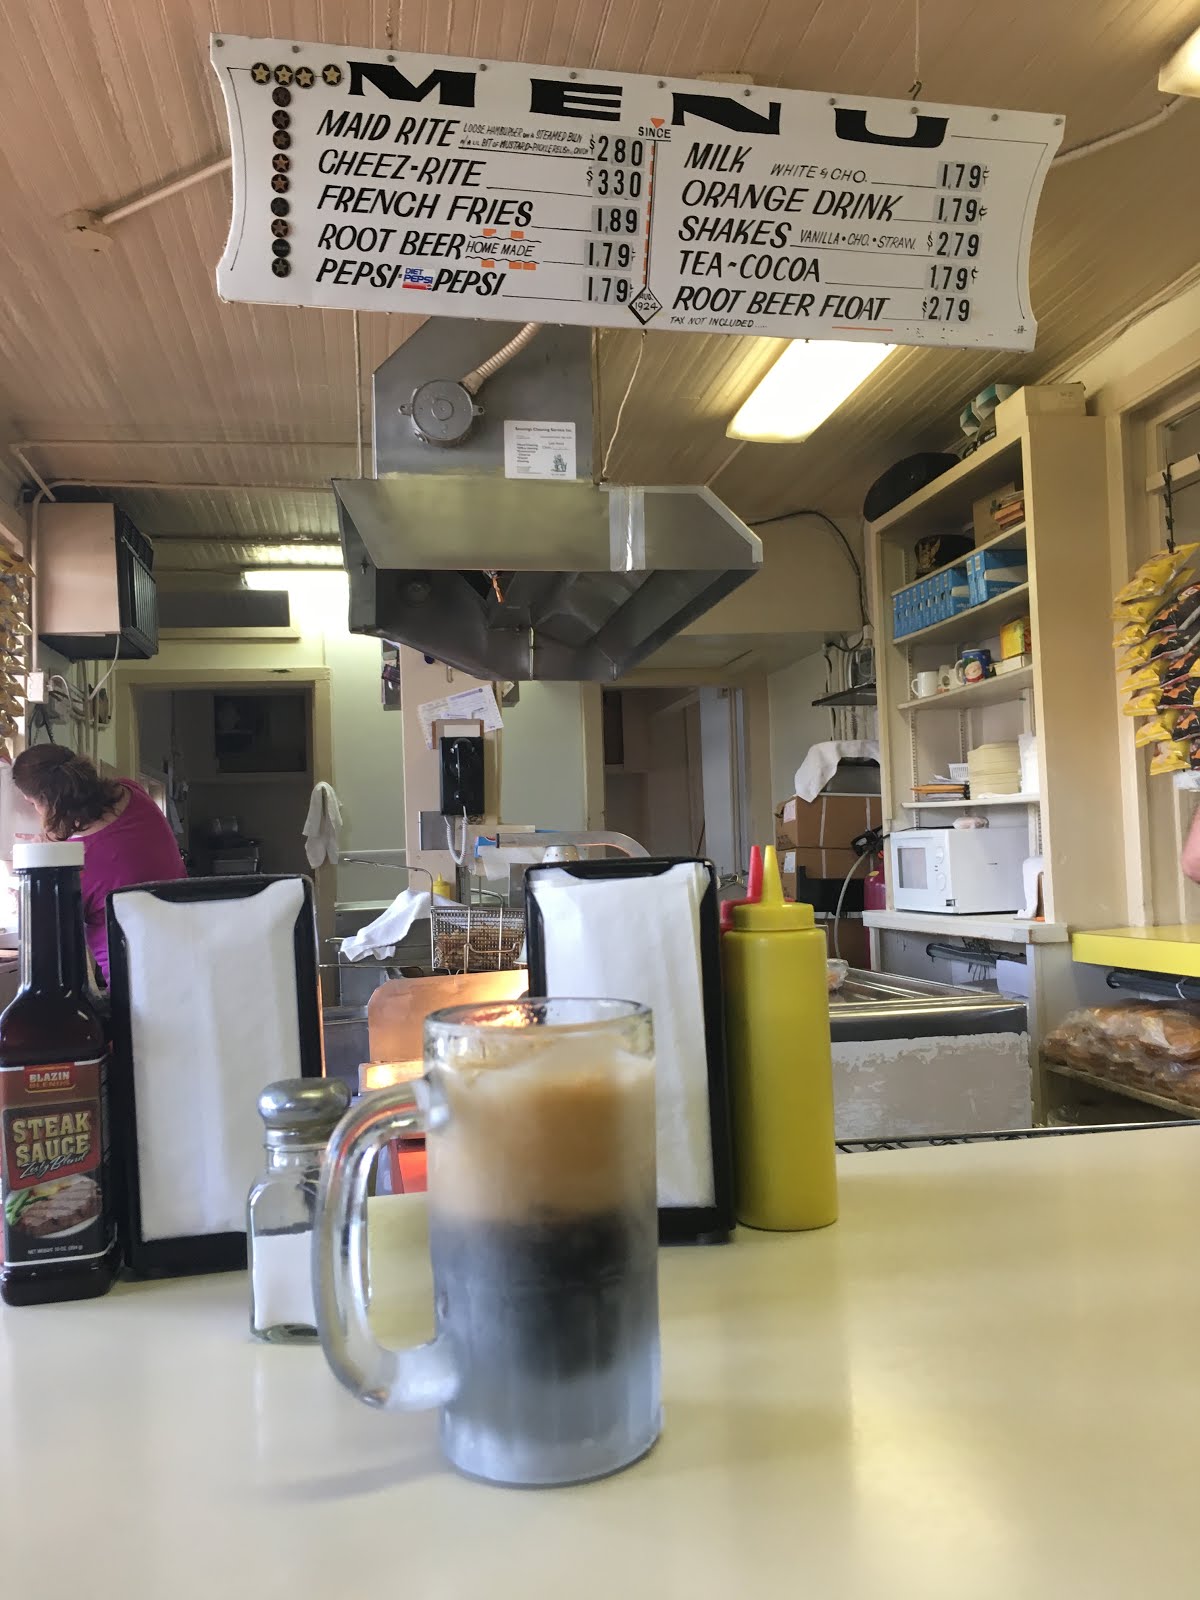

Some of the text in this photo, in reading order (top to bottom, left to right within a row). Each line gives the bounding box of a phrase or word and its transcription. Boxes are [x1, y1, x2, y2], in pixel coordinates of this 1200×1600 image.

[347, 60, 950, 148] MENU
[316, 109, 461, 147] MAID RITE
[463, 123, 486, 134] LOOSE
[535, 129, 567, 142] STEAMED
[567, 132, 583, 143] BUN
[638, 126, 671, 139] SINCE
[318, 149, 486, 187] CHEEZ-RITE
[684, 142, 752, 173] MILK
[770, 163, 818, 179] WHITE
[830, 168, 868, 183] CHO.
[317, 184, 533, 227] FRENCH FRIES
[682, 179, 903, 222] ORANGE DRINK
[317, 224, 466, 260] ROOT BEER
[678, 215, 792, 249] SHAKES
[800, 229, 839, 245] VANILLA
[465, 241, 535, 257] HOME MADE
[404, 274, 433, 284] PEPSI
[405, 267, 424, 276] DIET
[432, 269, 506, 296] PEPSI
[635, 302, 658, 311] 1924
[672, 285, 891, 321] ROOT BEER FLOAT
[670, 316, 685, 325] TAX
[688, 317, 707, 326] NOT
[29, 1071, 70, 1083] BLAZIN
[12, 1111, 90, 1143] STEAK
[15, 1134, 90, 1167] SAUCE
[50, 1152, 87, 1171] Blend
